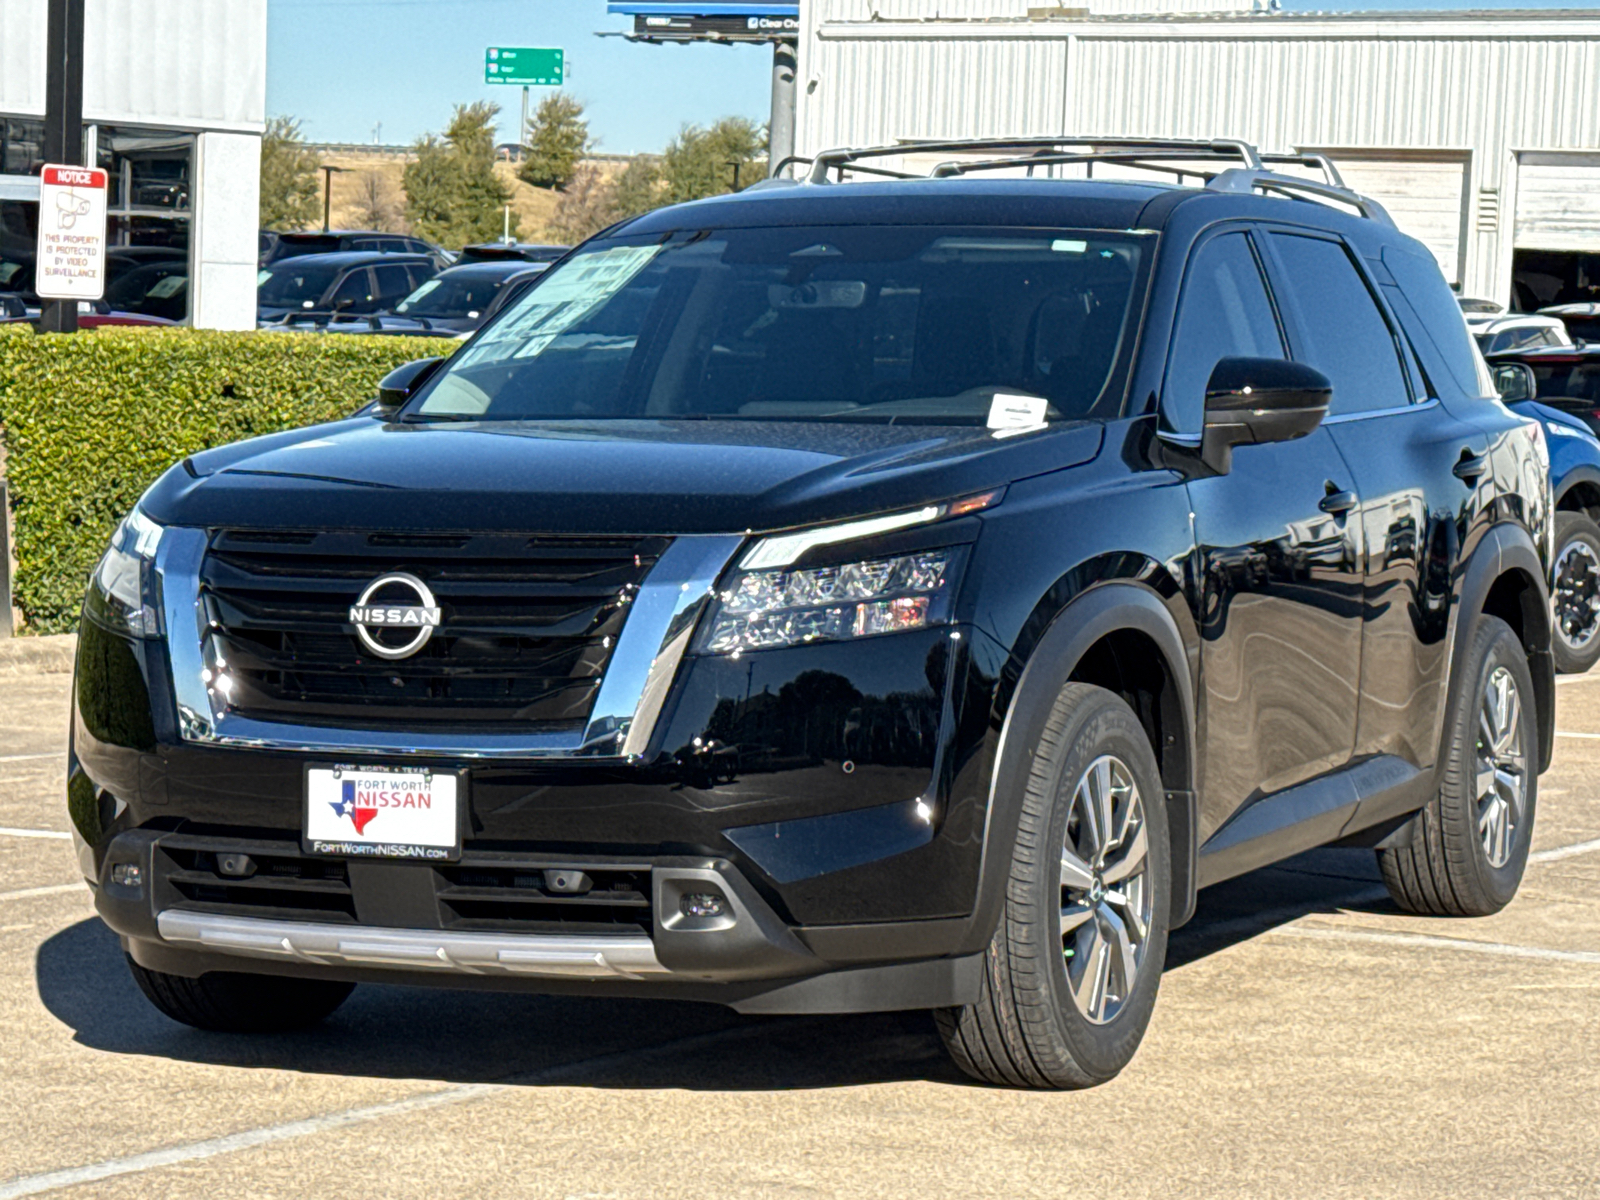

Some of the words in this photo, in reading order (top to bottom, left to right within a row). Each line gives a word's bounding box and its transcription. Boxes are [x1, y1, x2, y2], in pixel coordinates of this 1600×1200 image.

[57, 170, 92, 184] NOTICE
[45, 234, 60, 243] THIS
[63, 234, 99, 245] PROPERTY
[46, 246, 53, 254] IS
[56, 246, 97, 256] PROTECTED
[55, 257, 64, 265] BY
[67, 257, 88, 266] VIDEO
[45, 268, 97, 278] SURVEILLANCE
[350, 608, 437, 624] NISSAN
[359, 765, 390, 773] WORTH
[357, 780, 386, 789] FORT
[390, 780, 431, 791] WORTH
[357, 791, 431, 809] NISSAN
